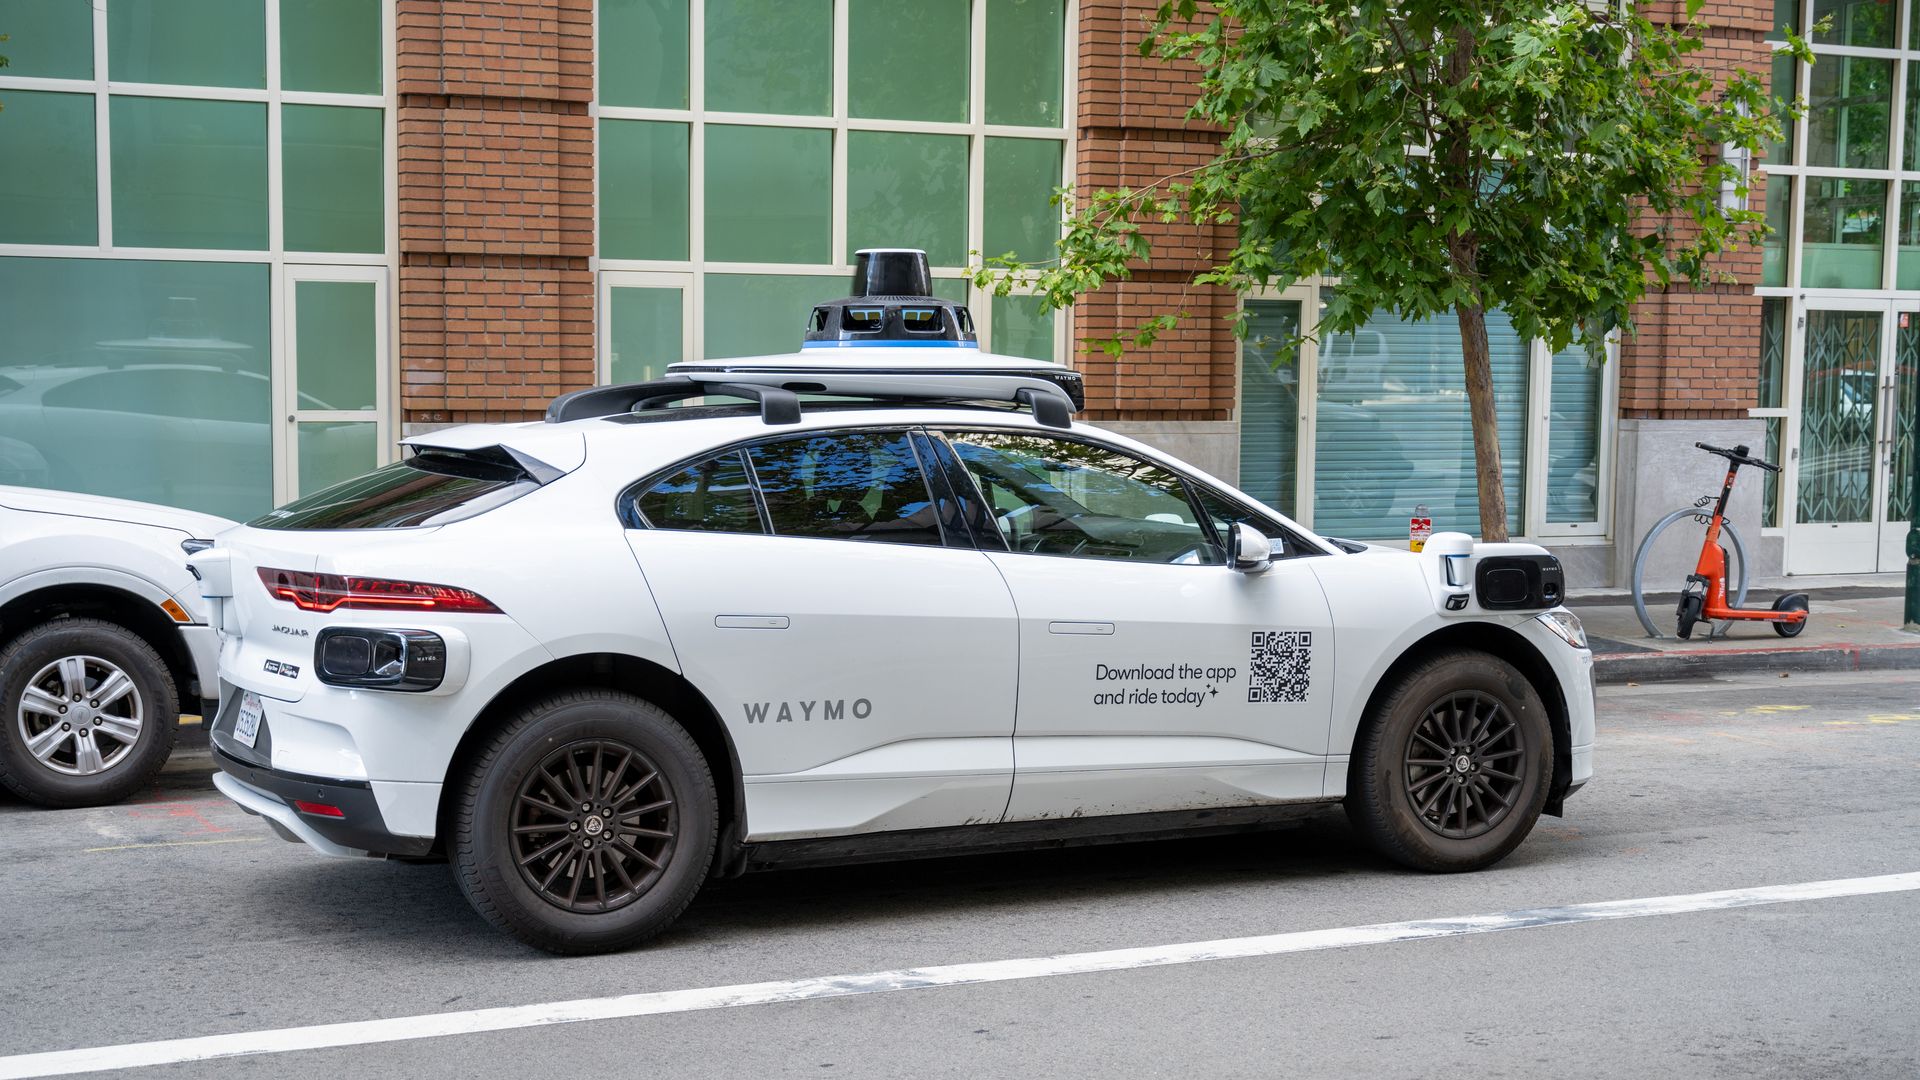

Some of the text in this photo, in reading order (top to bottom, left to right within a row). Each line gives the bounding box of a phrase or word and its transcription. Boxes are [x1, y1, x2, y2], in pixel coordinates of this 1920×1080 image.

[271, 624, 309, 637] JAGUAR
[1095, 663, 1237, 683] Download the app
[1093, 687, 1206, 708] and ride today
[742, 698, 873, 724] WAYMO
